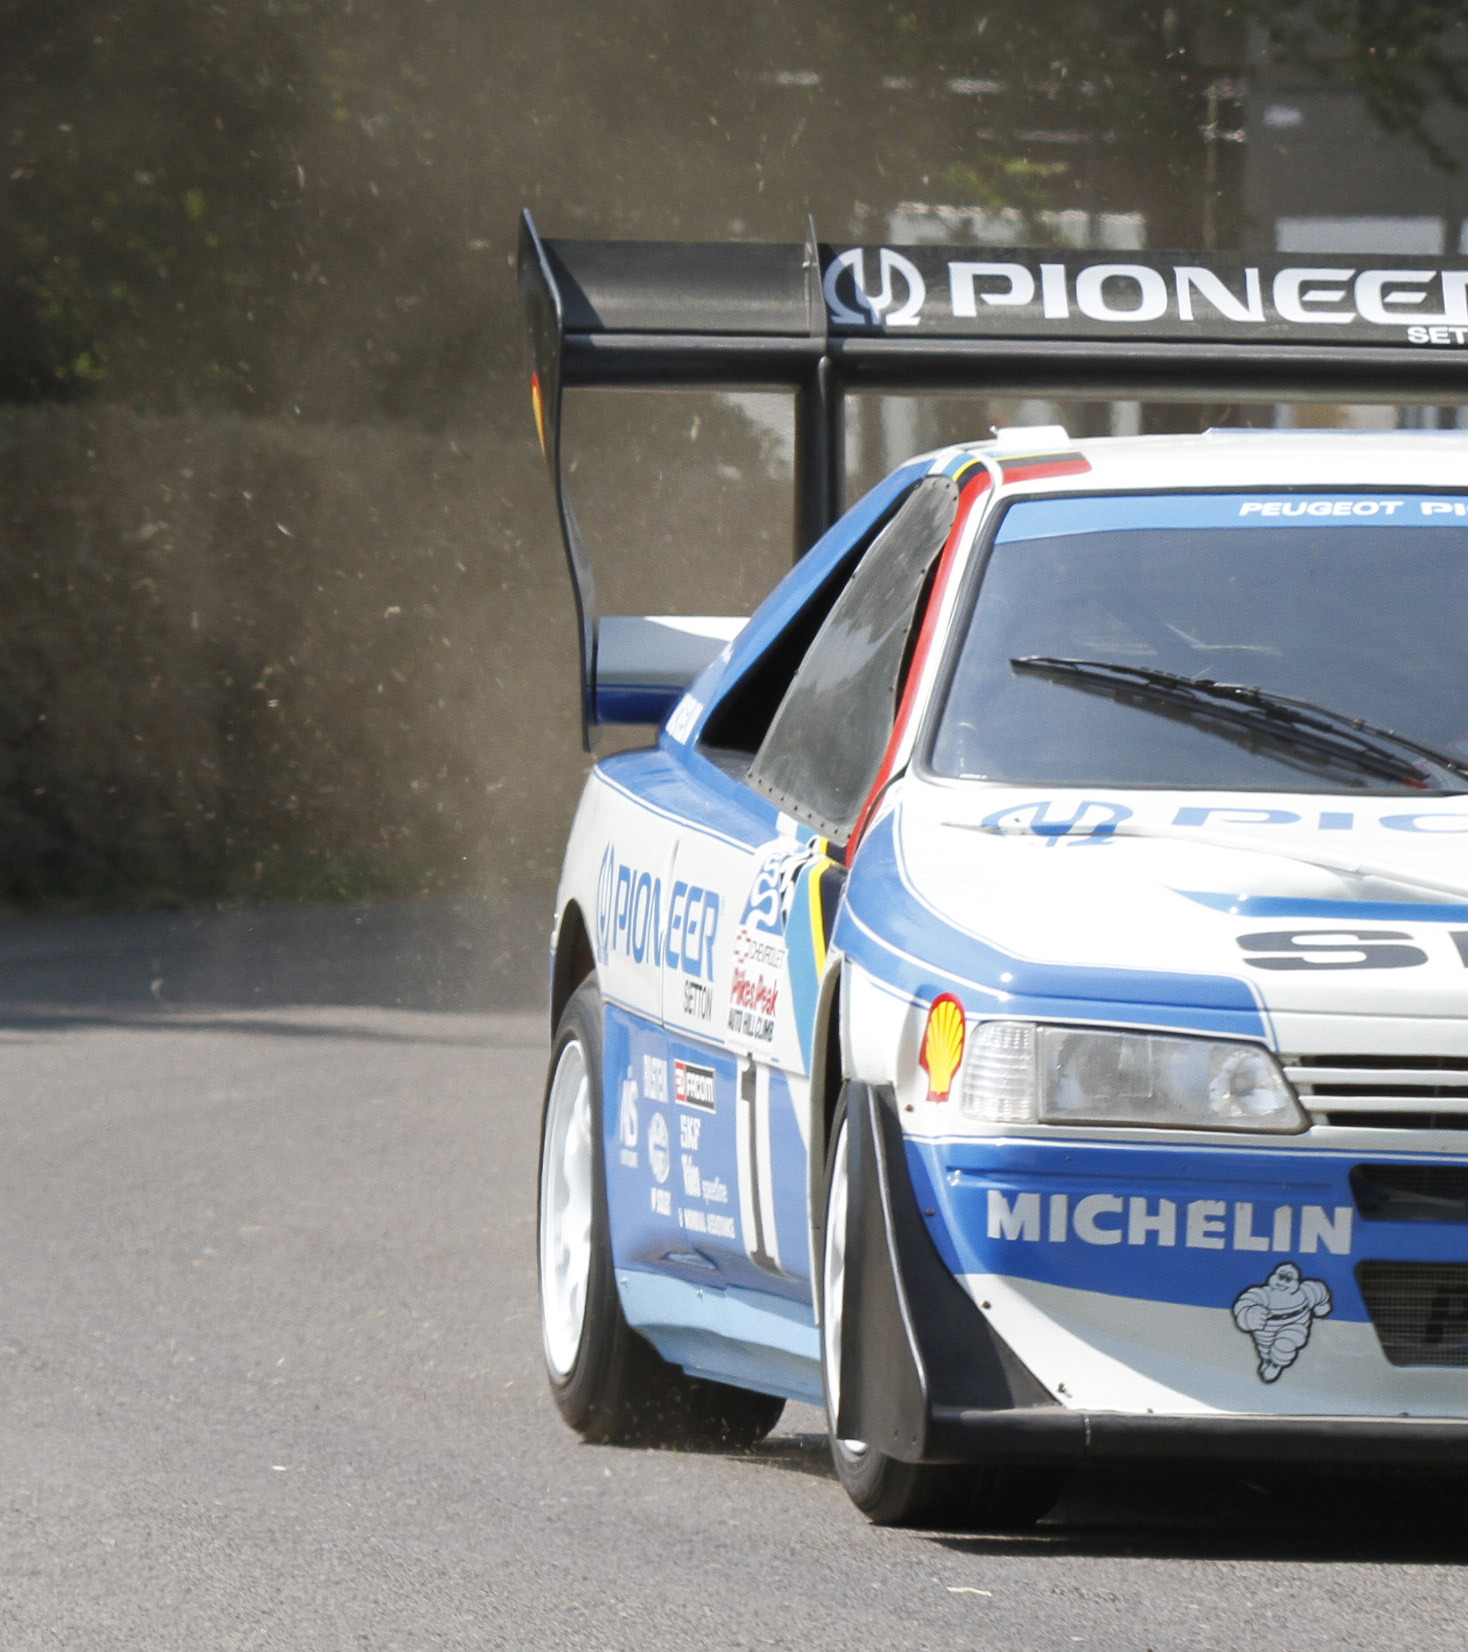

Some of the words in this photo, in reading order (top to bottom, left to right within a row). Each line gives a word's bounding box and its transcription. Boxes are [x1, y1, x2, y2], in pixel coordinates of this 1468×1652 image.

[1239, 501, 1404, 517] PEUGEOT
[612, 864, 721, 983] PIONEER
[684, 979, 714, 1022] SETTON
[680, 1113, 701, 1151] SKF
[986, 1189, 1354, 1256] MICHELIN
